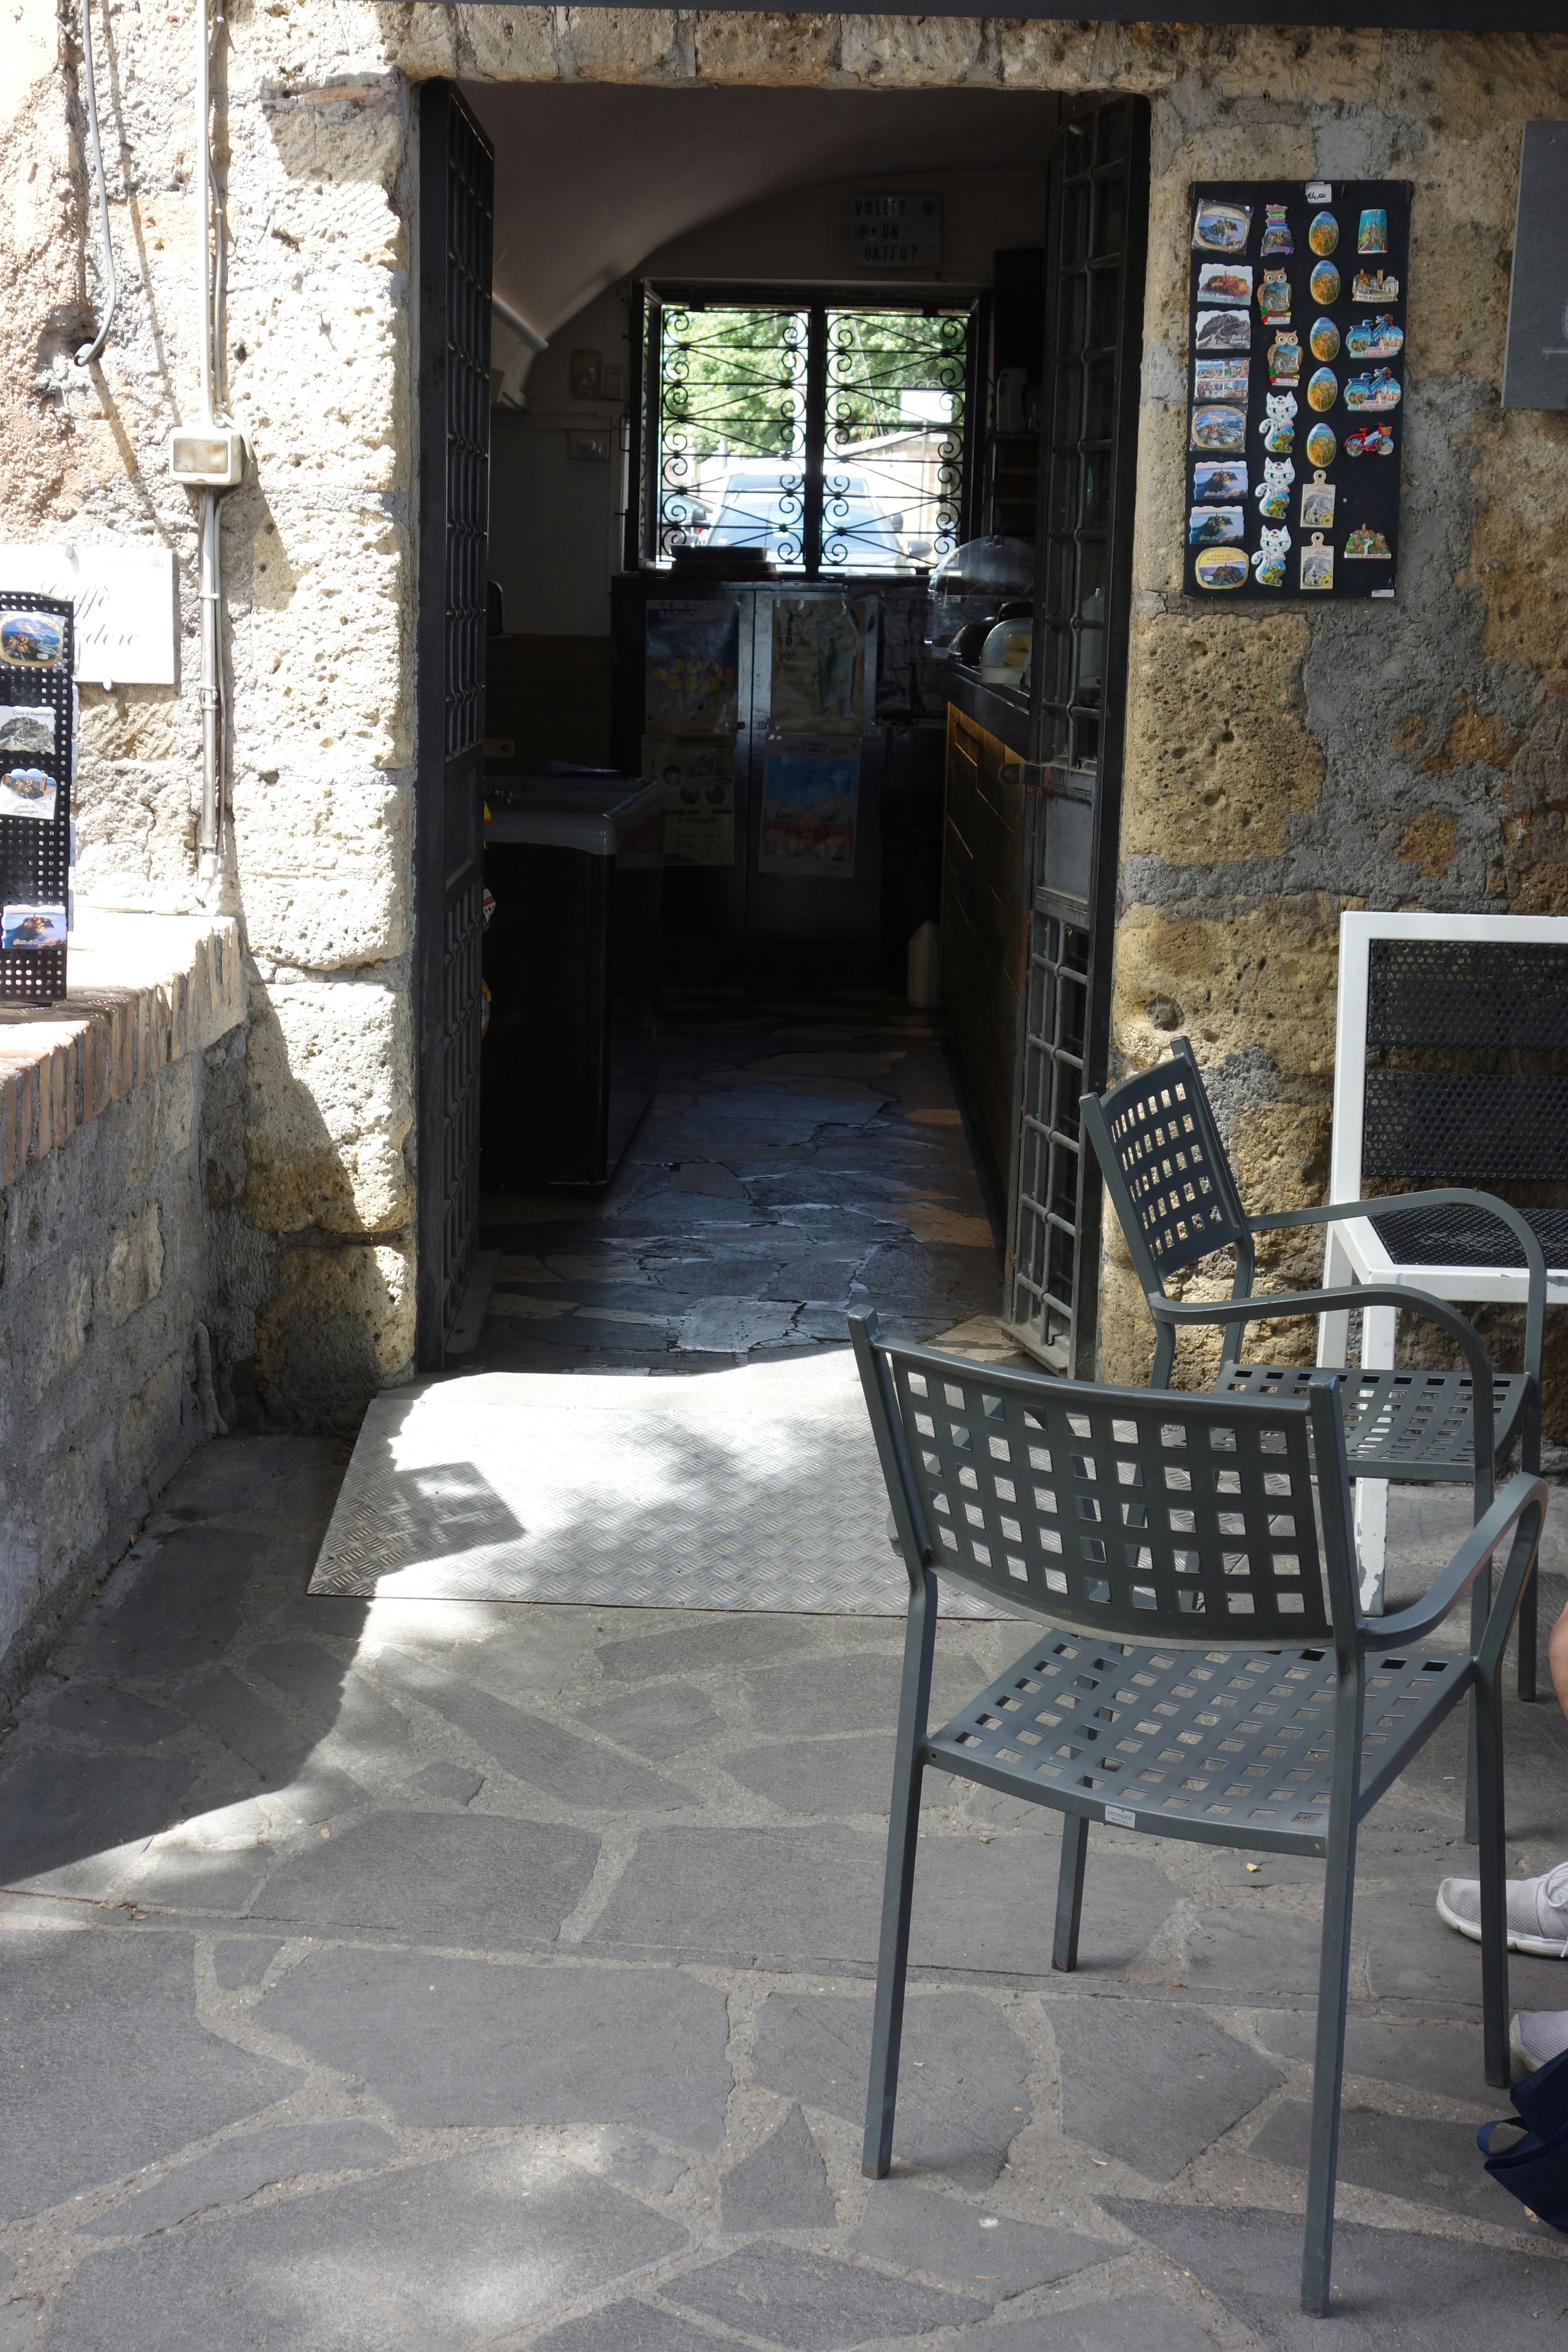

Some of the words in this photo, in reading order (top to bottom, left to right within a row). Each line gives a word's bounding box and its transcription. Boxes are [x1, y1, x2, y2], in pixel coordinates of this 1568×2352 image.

[855, 200, 906, 215] VOLETE
[882, 223, 898, 238] UN
[864, 246, 917, 261] GATTO?
[1108, 1810, 1132, 1821] vermobil
